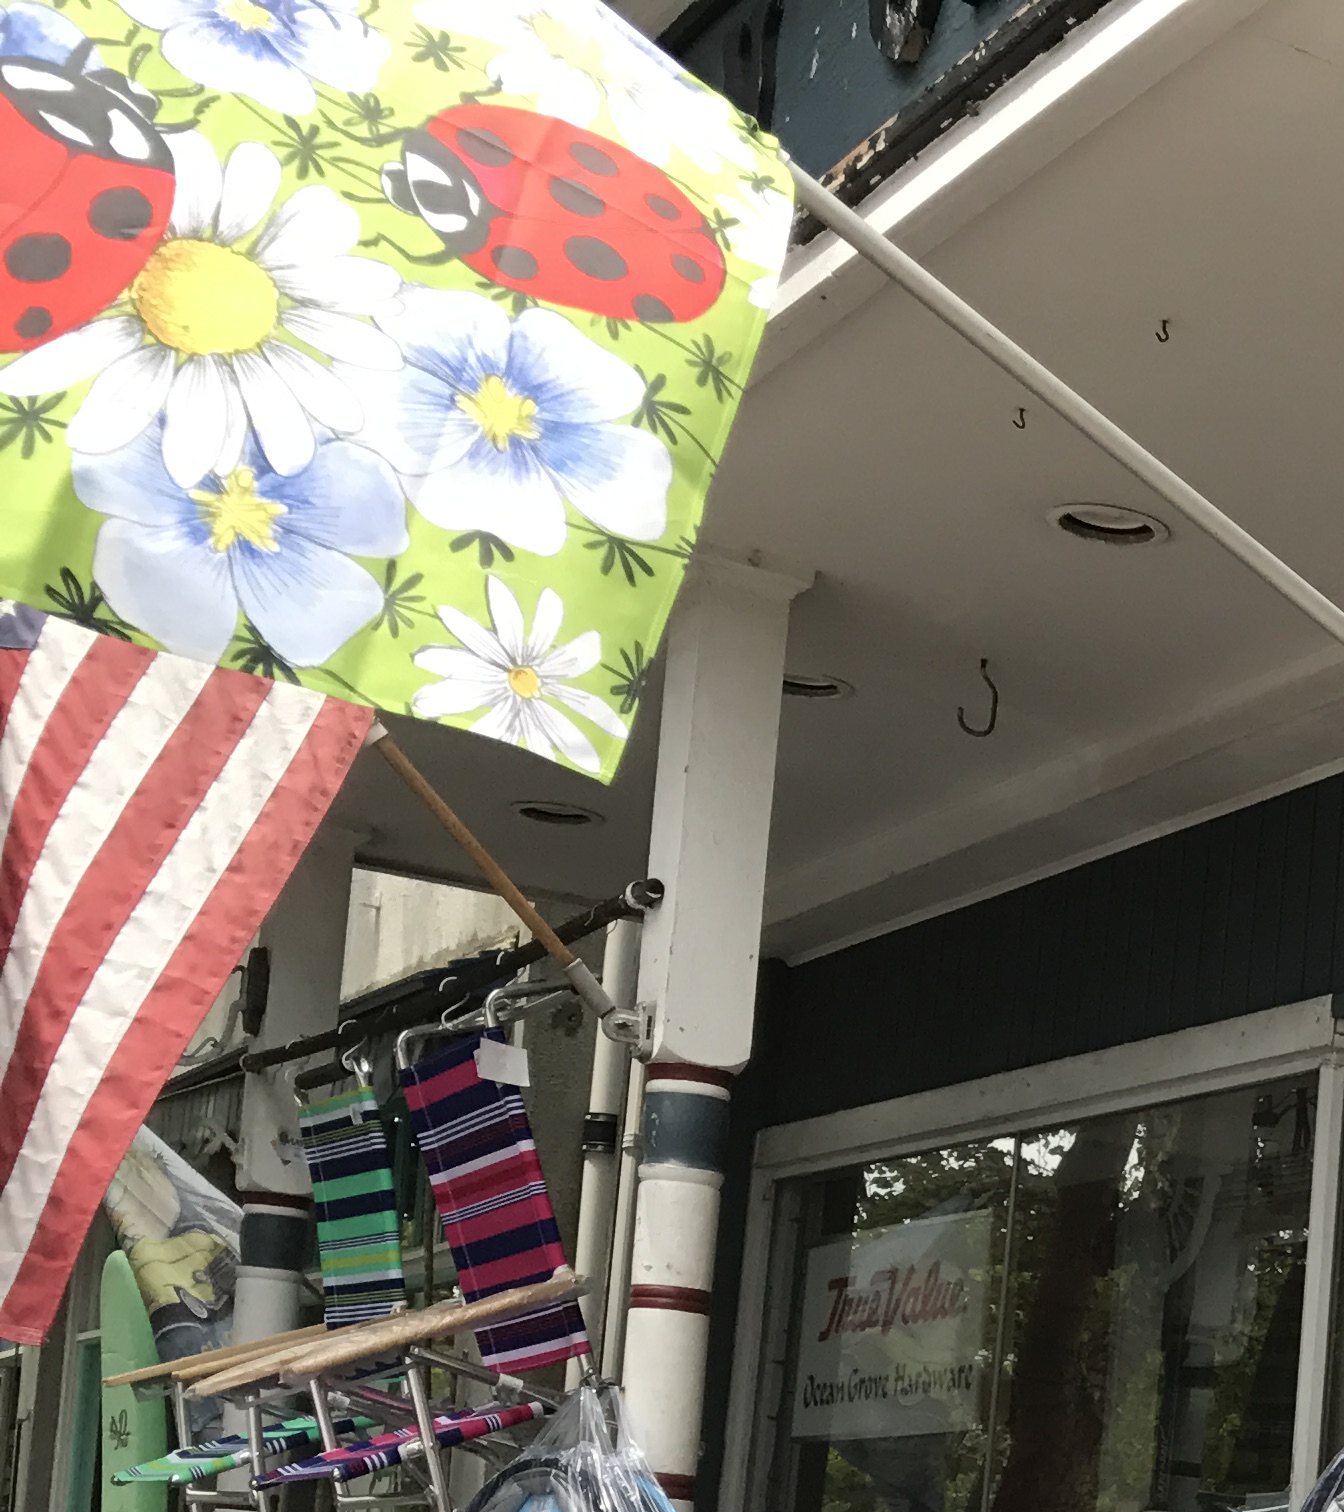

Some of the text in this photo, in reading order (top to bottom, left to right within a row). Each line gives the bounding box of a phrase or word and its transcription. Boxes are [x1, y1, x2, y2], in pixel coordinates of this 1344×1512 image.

[803, 1361, 974, 1409] Ocean Grove Hardware
